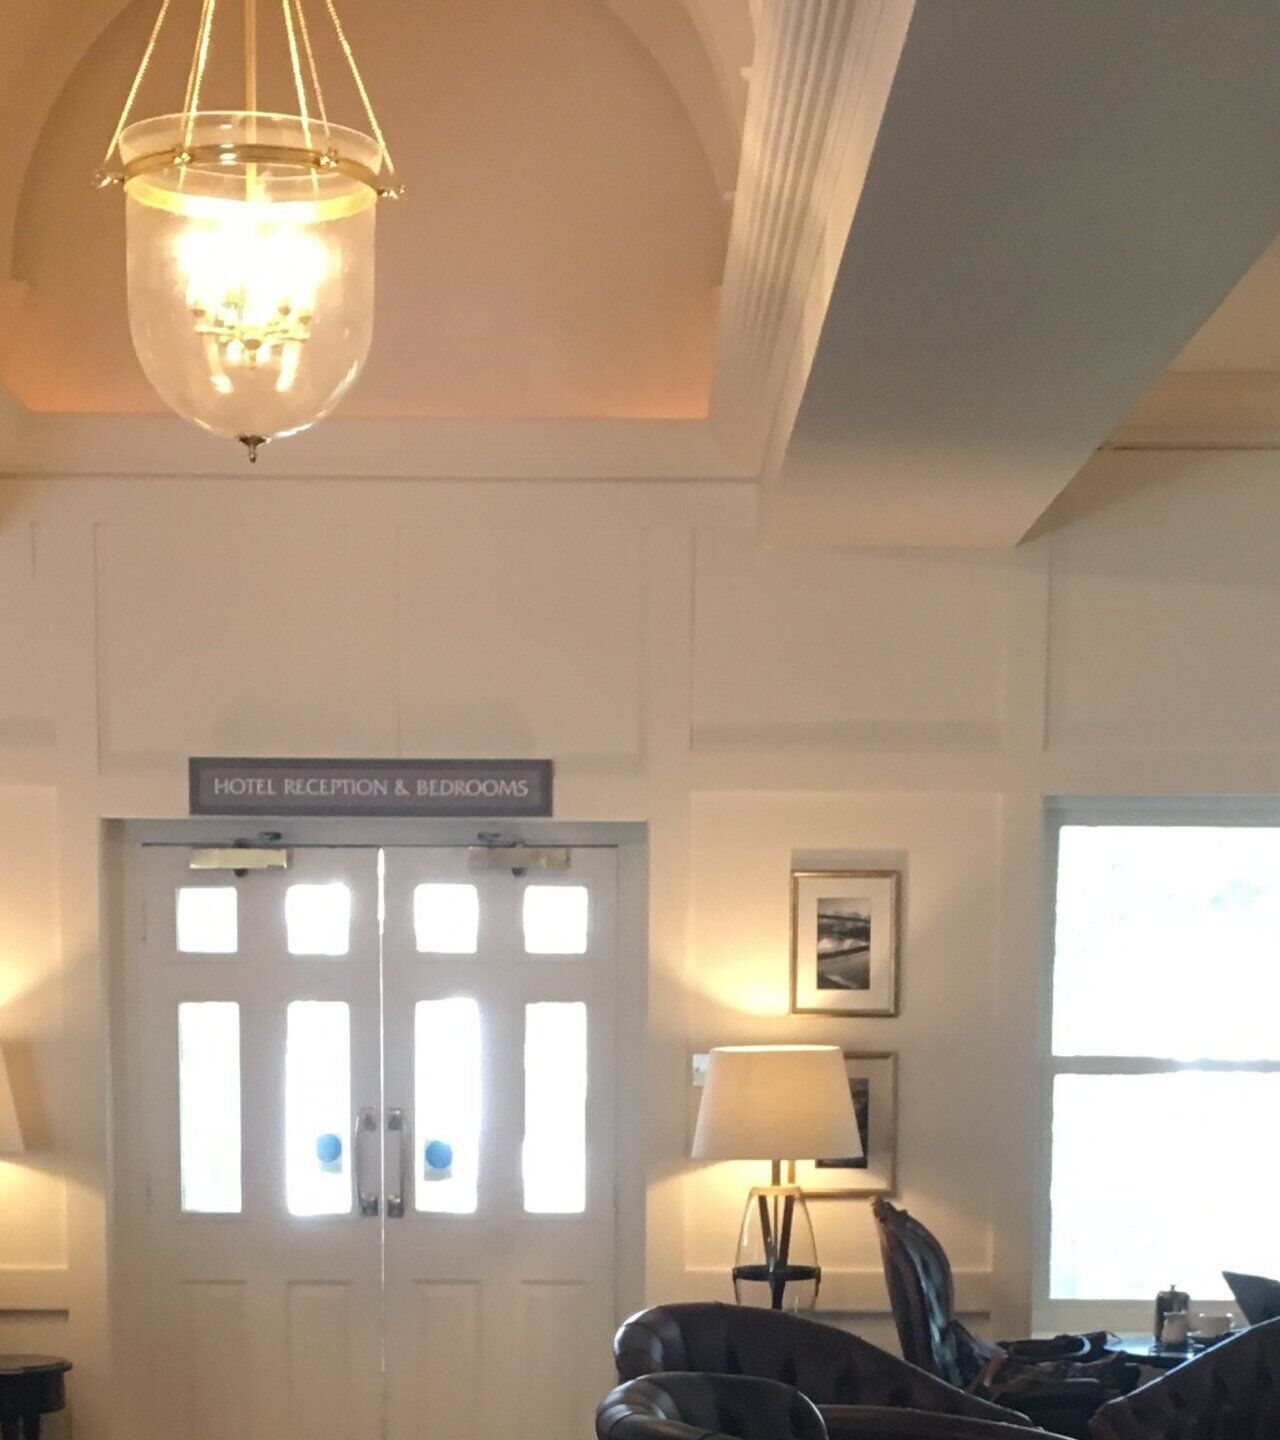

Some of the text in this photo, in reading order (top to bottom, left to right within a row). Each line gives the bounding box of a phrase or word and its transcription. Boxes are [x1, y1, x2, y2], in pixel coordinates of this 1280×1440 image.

[213, 778, 528, 797] HOTEL RECEPTION & BEDROOMS
